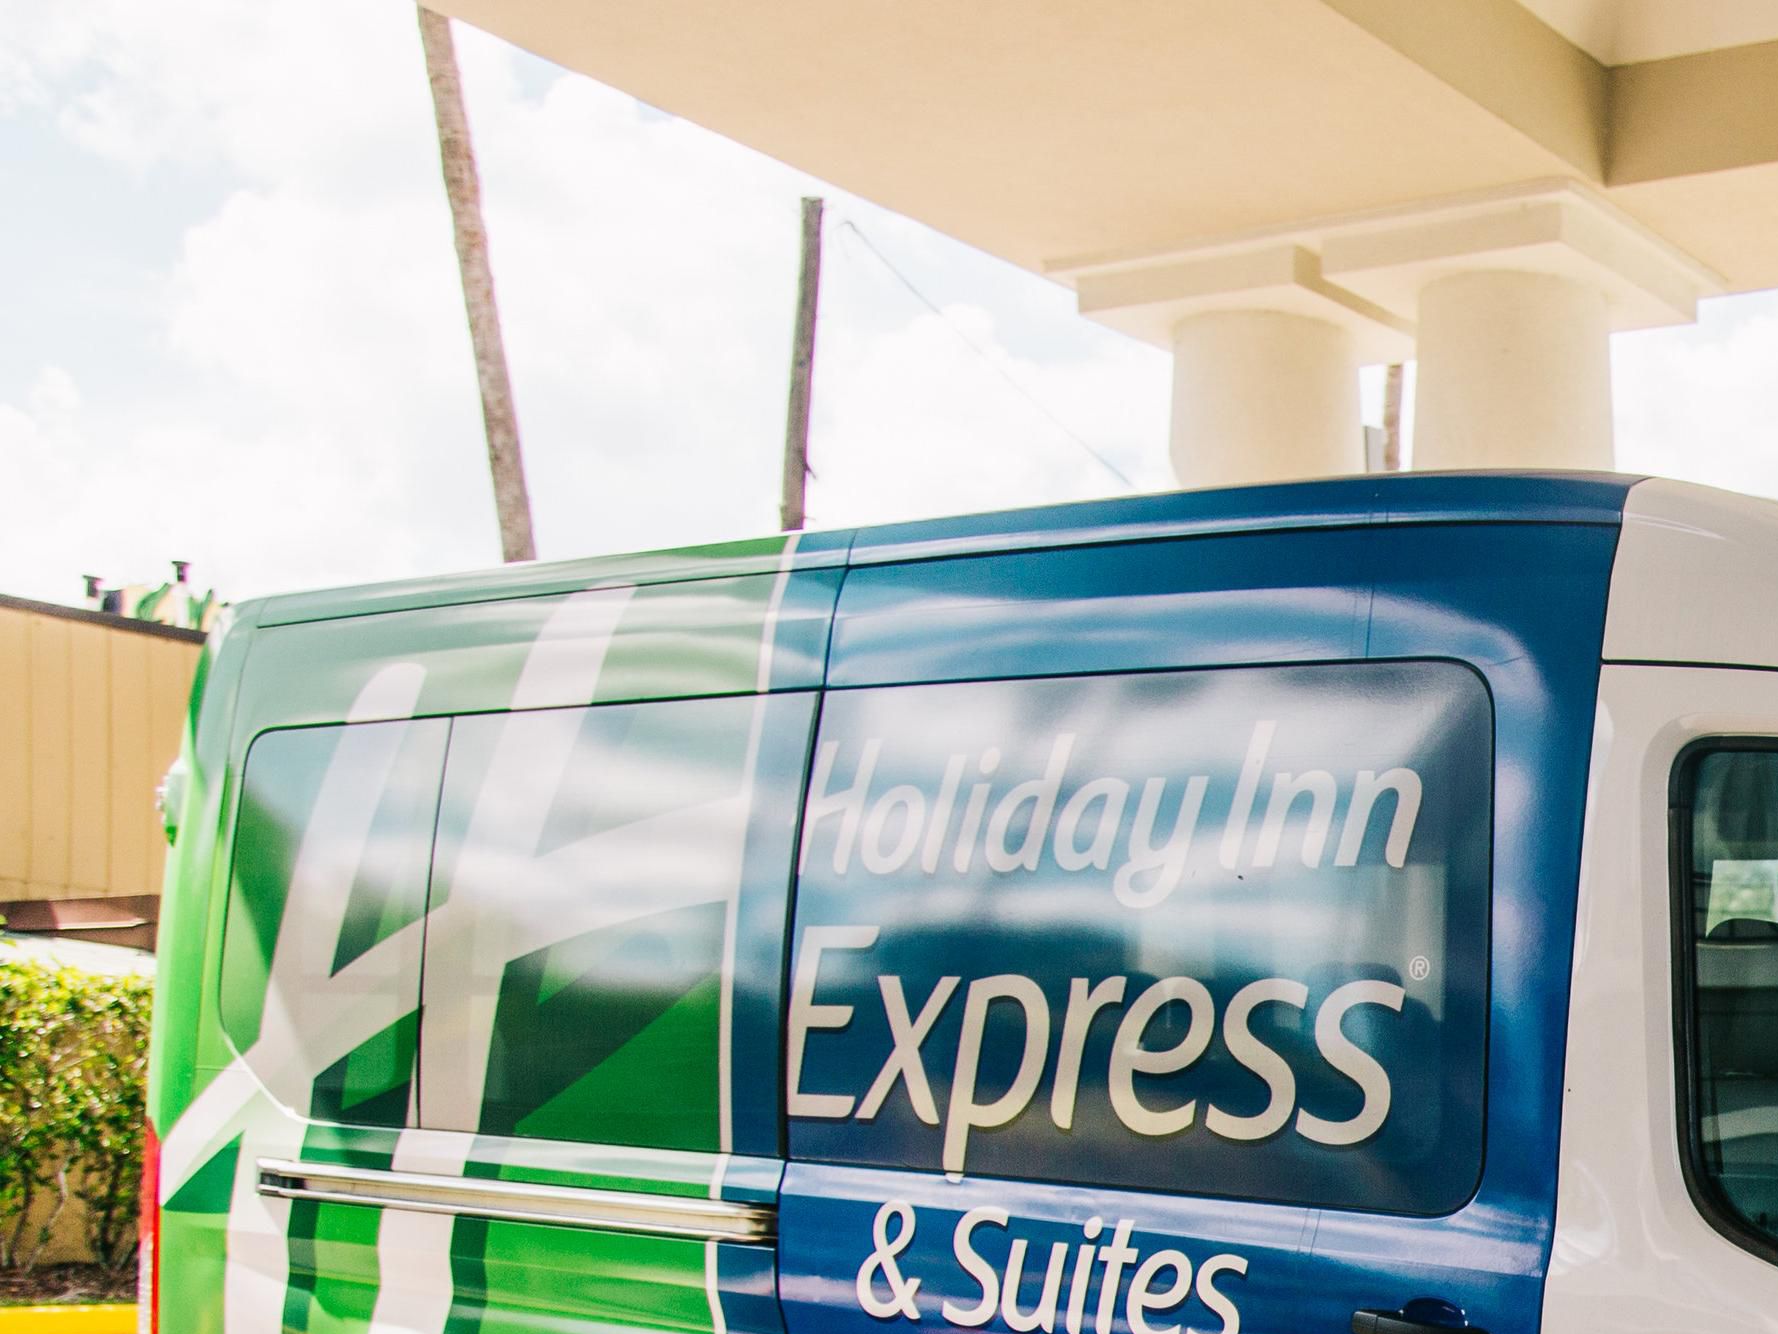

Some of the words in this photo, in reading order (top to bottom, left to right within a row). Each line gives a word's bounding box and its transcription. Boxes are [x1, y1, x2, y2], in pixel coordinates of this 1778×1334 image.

[797, 731, 1210, 909] Holiday
[1219, 718, 1424, 870] Inn
[786, 925, 1406, 1183] Express
[855, 1199, 922, 1322] &
